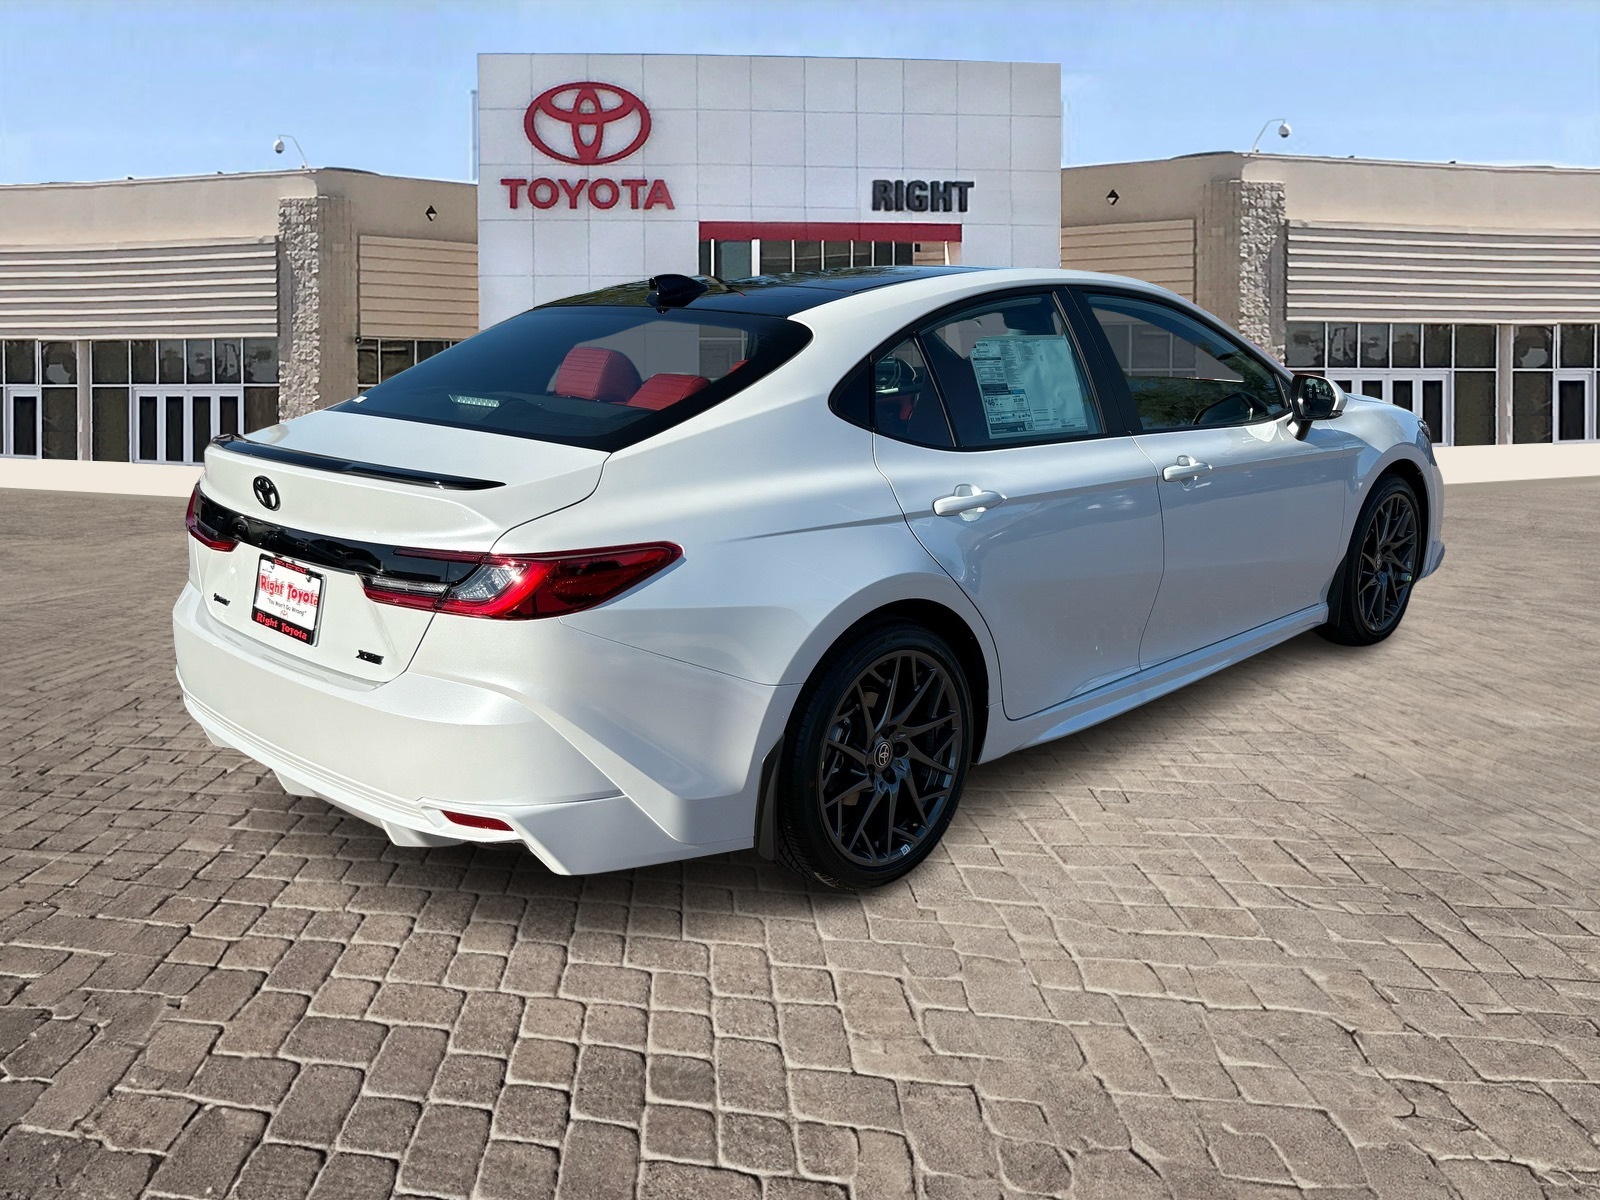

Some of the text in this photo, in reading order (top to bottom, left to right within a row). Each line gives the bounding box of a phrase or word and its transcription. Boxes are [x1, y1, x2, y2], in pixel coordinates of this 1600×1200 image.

[500, 178, 675, 210] TOYOTA
[872, 179, 975, 212] RIGHT
[260, 574, 319, 607] Right Toyota
[256, 612, 308, 640] Right Toyota
